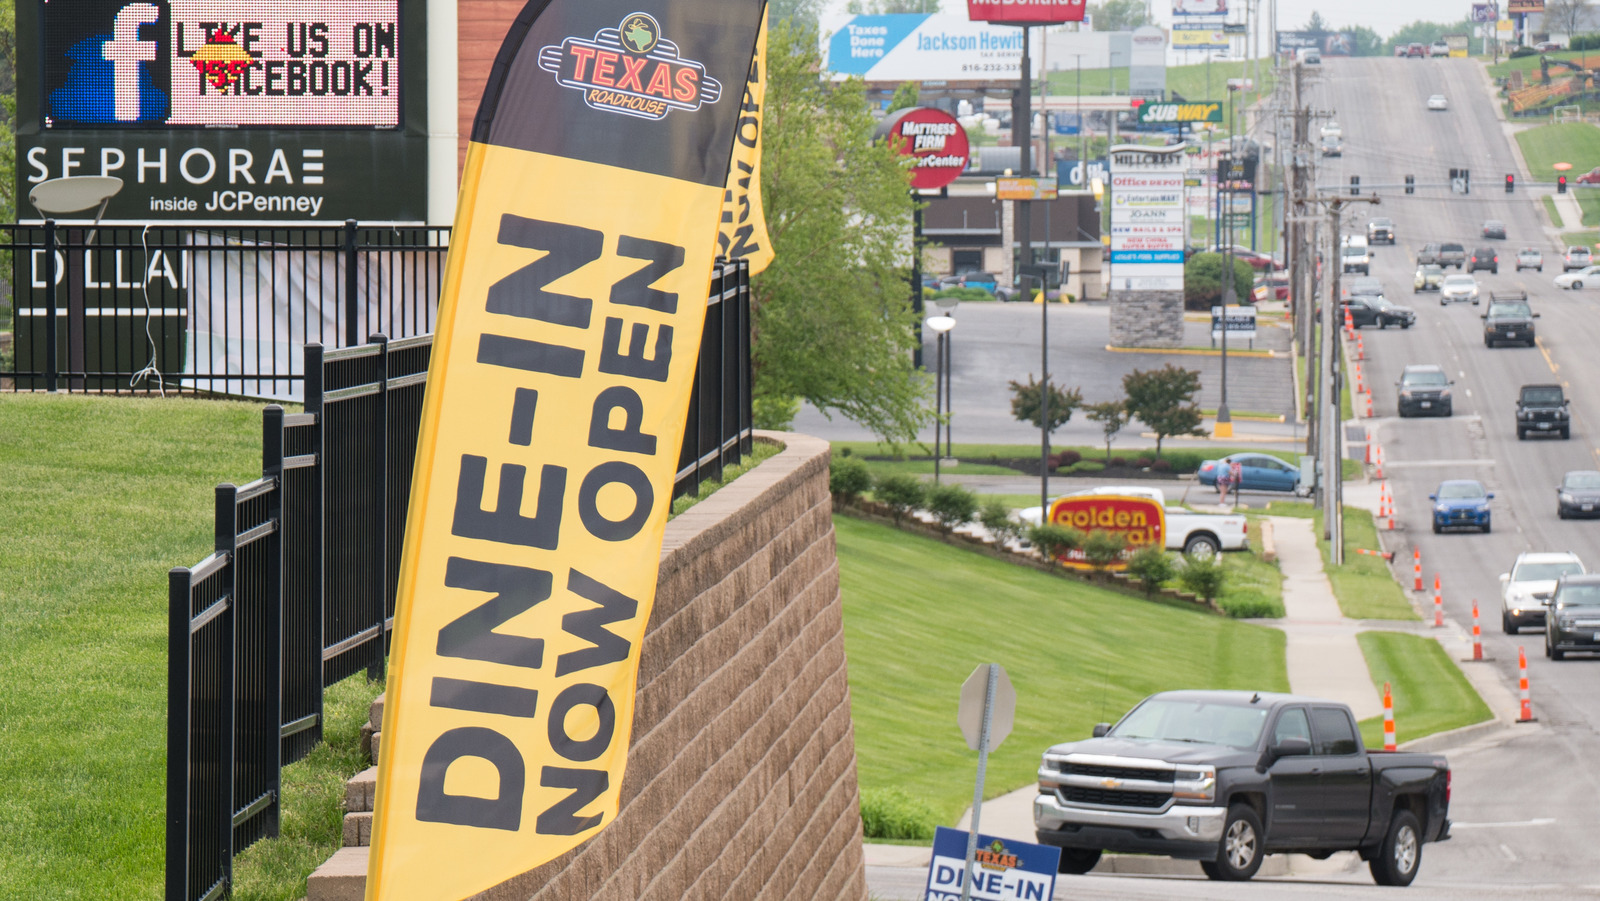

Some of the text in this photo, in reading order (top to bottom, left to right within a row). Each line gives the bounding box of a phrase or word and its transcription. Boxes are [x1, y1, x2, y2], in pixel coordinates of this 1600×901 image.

[287, 22, 329, 58] US
[353, 22, 395, 58] ON
[848, 25, 888, 36] Taxes
[850, 36, 885, 47] Done
[917, 31, 1025, 51] Jackson Hewit
[851, 47, 884, 58] Here
[200, 60, 389, 96] CEBOOK!
[570, 45, 699, 101] TEXAS
[588, 88, 667, 115] ROADHOUSE
[1142, 103, 1219, 121] SUBWAY
[902, 121, 957, 136] MATTRESS
[914, 134, 946, 149] FIRM
[1114, 153, 1183, 165] HILLCREST
[1113, 177, 1148, 187] Office
[1149, 179, 1182, 187] DEPOT
[150, 191, 323, 216] inside JCPenney
[31, 249, 188, 289] DLLA
[577, 234, 686, 542] OPEN
[415, 212, 605, 832] DINE-IN
[1057, 506, 1147, 528] golden
[535, 567, 639, 836] NOW
[976, 850, 1017, 868] TEXAS
[936, 864, 1044, 901] DINE-IN
